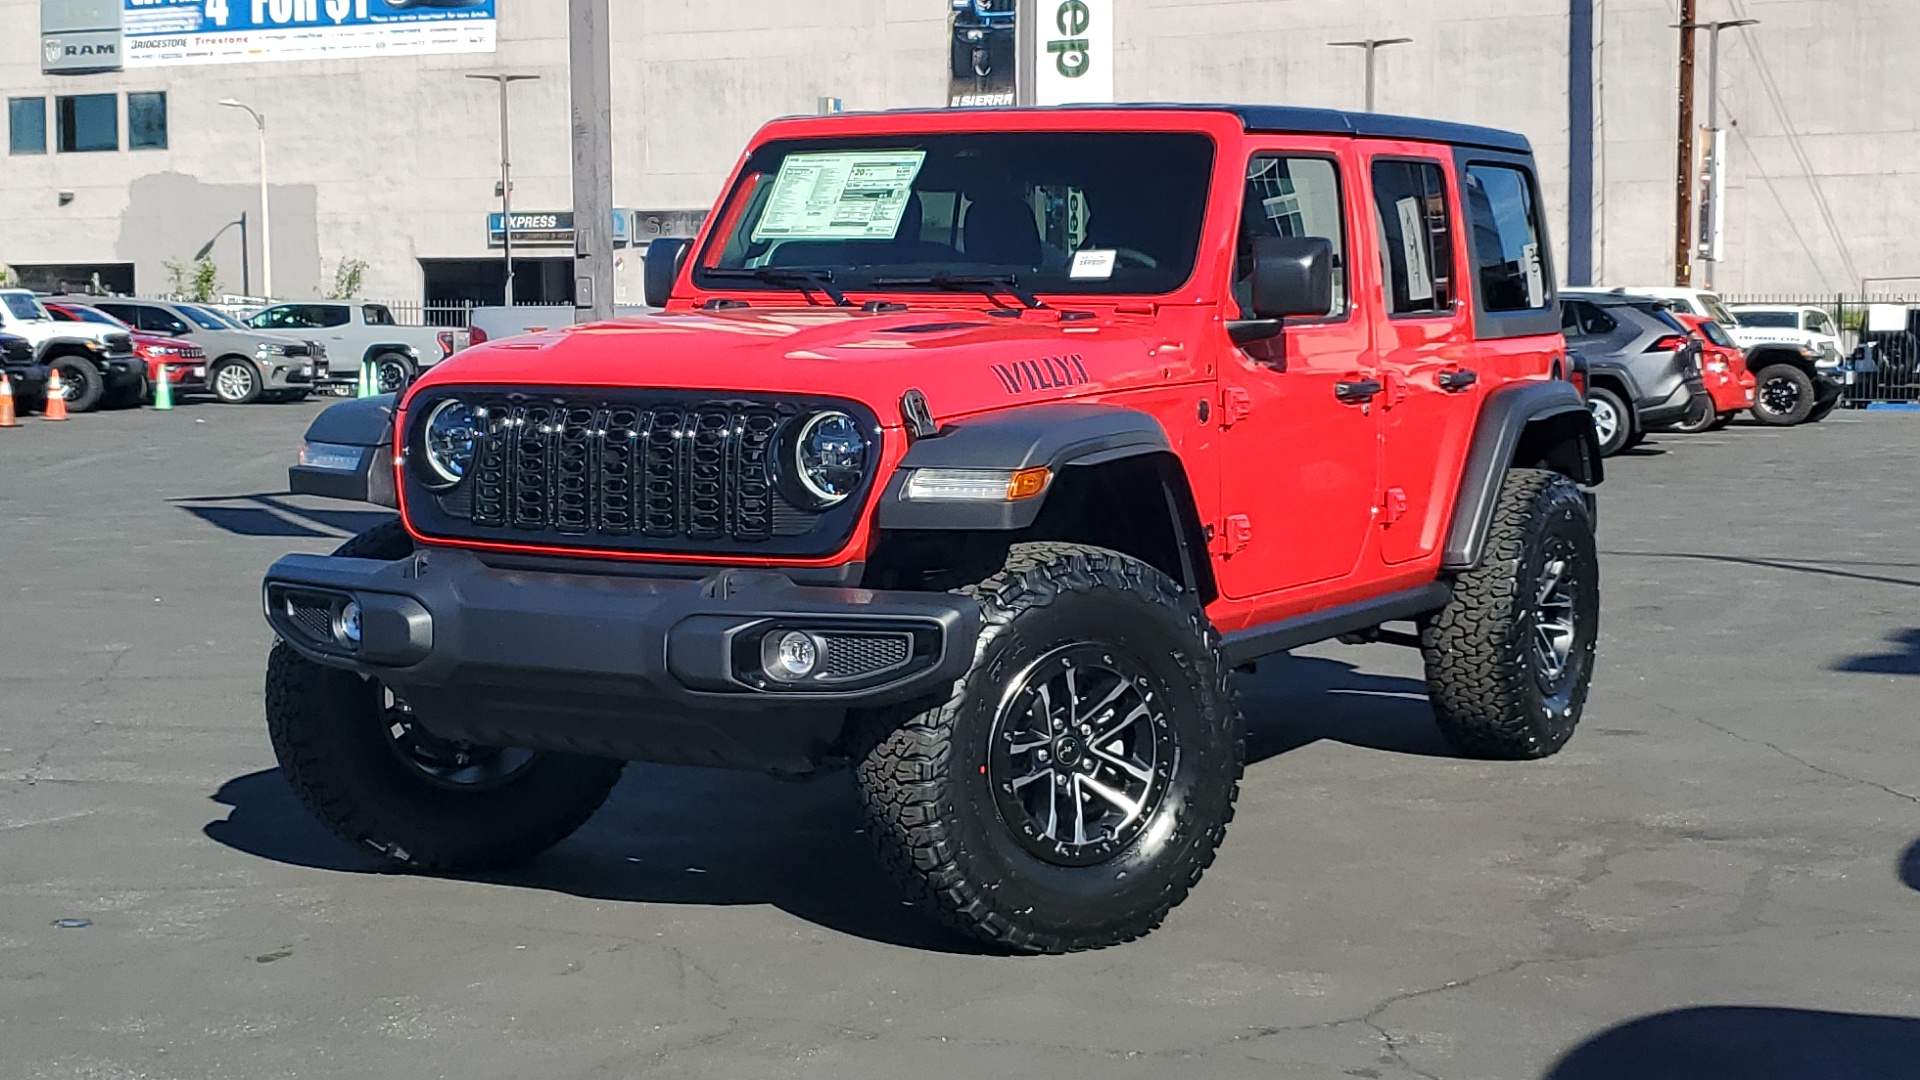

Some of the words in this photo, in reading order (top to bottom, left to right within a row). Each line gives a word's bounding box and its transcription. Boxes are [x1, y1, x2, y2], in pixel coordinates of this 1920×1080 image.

[205, 0, 230, 26] 4
[65, 44, 115, 56] RAM
[130, 38, 187, 50] BRIDGESTONE
[195, 37, 248, 46] Firestone
[960, 94, 1013, 107] SIERRA
[991, 354, 1089, 394] WILLYS
